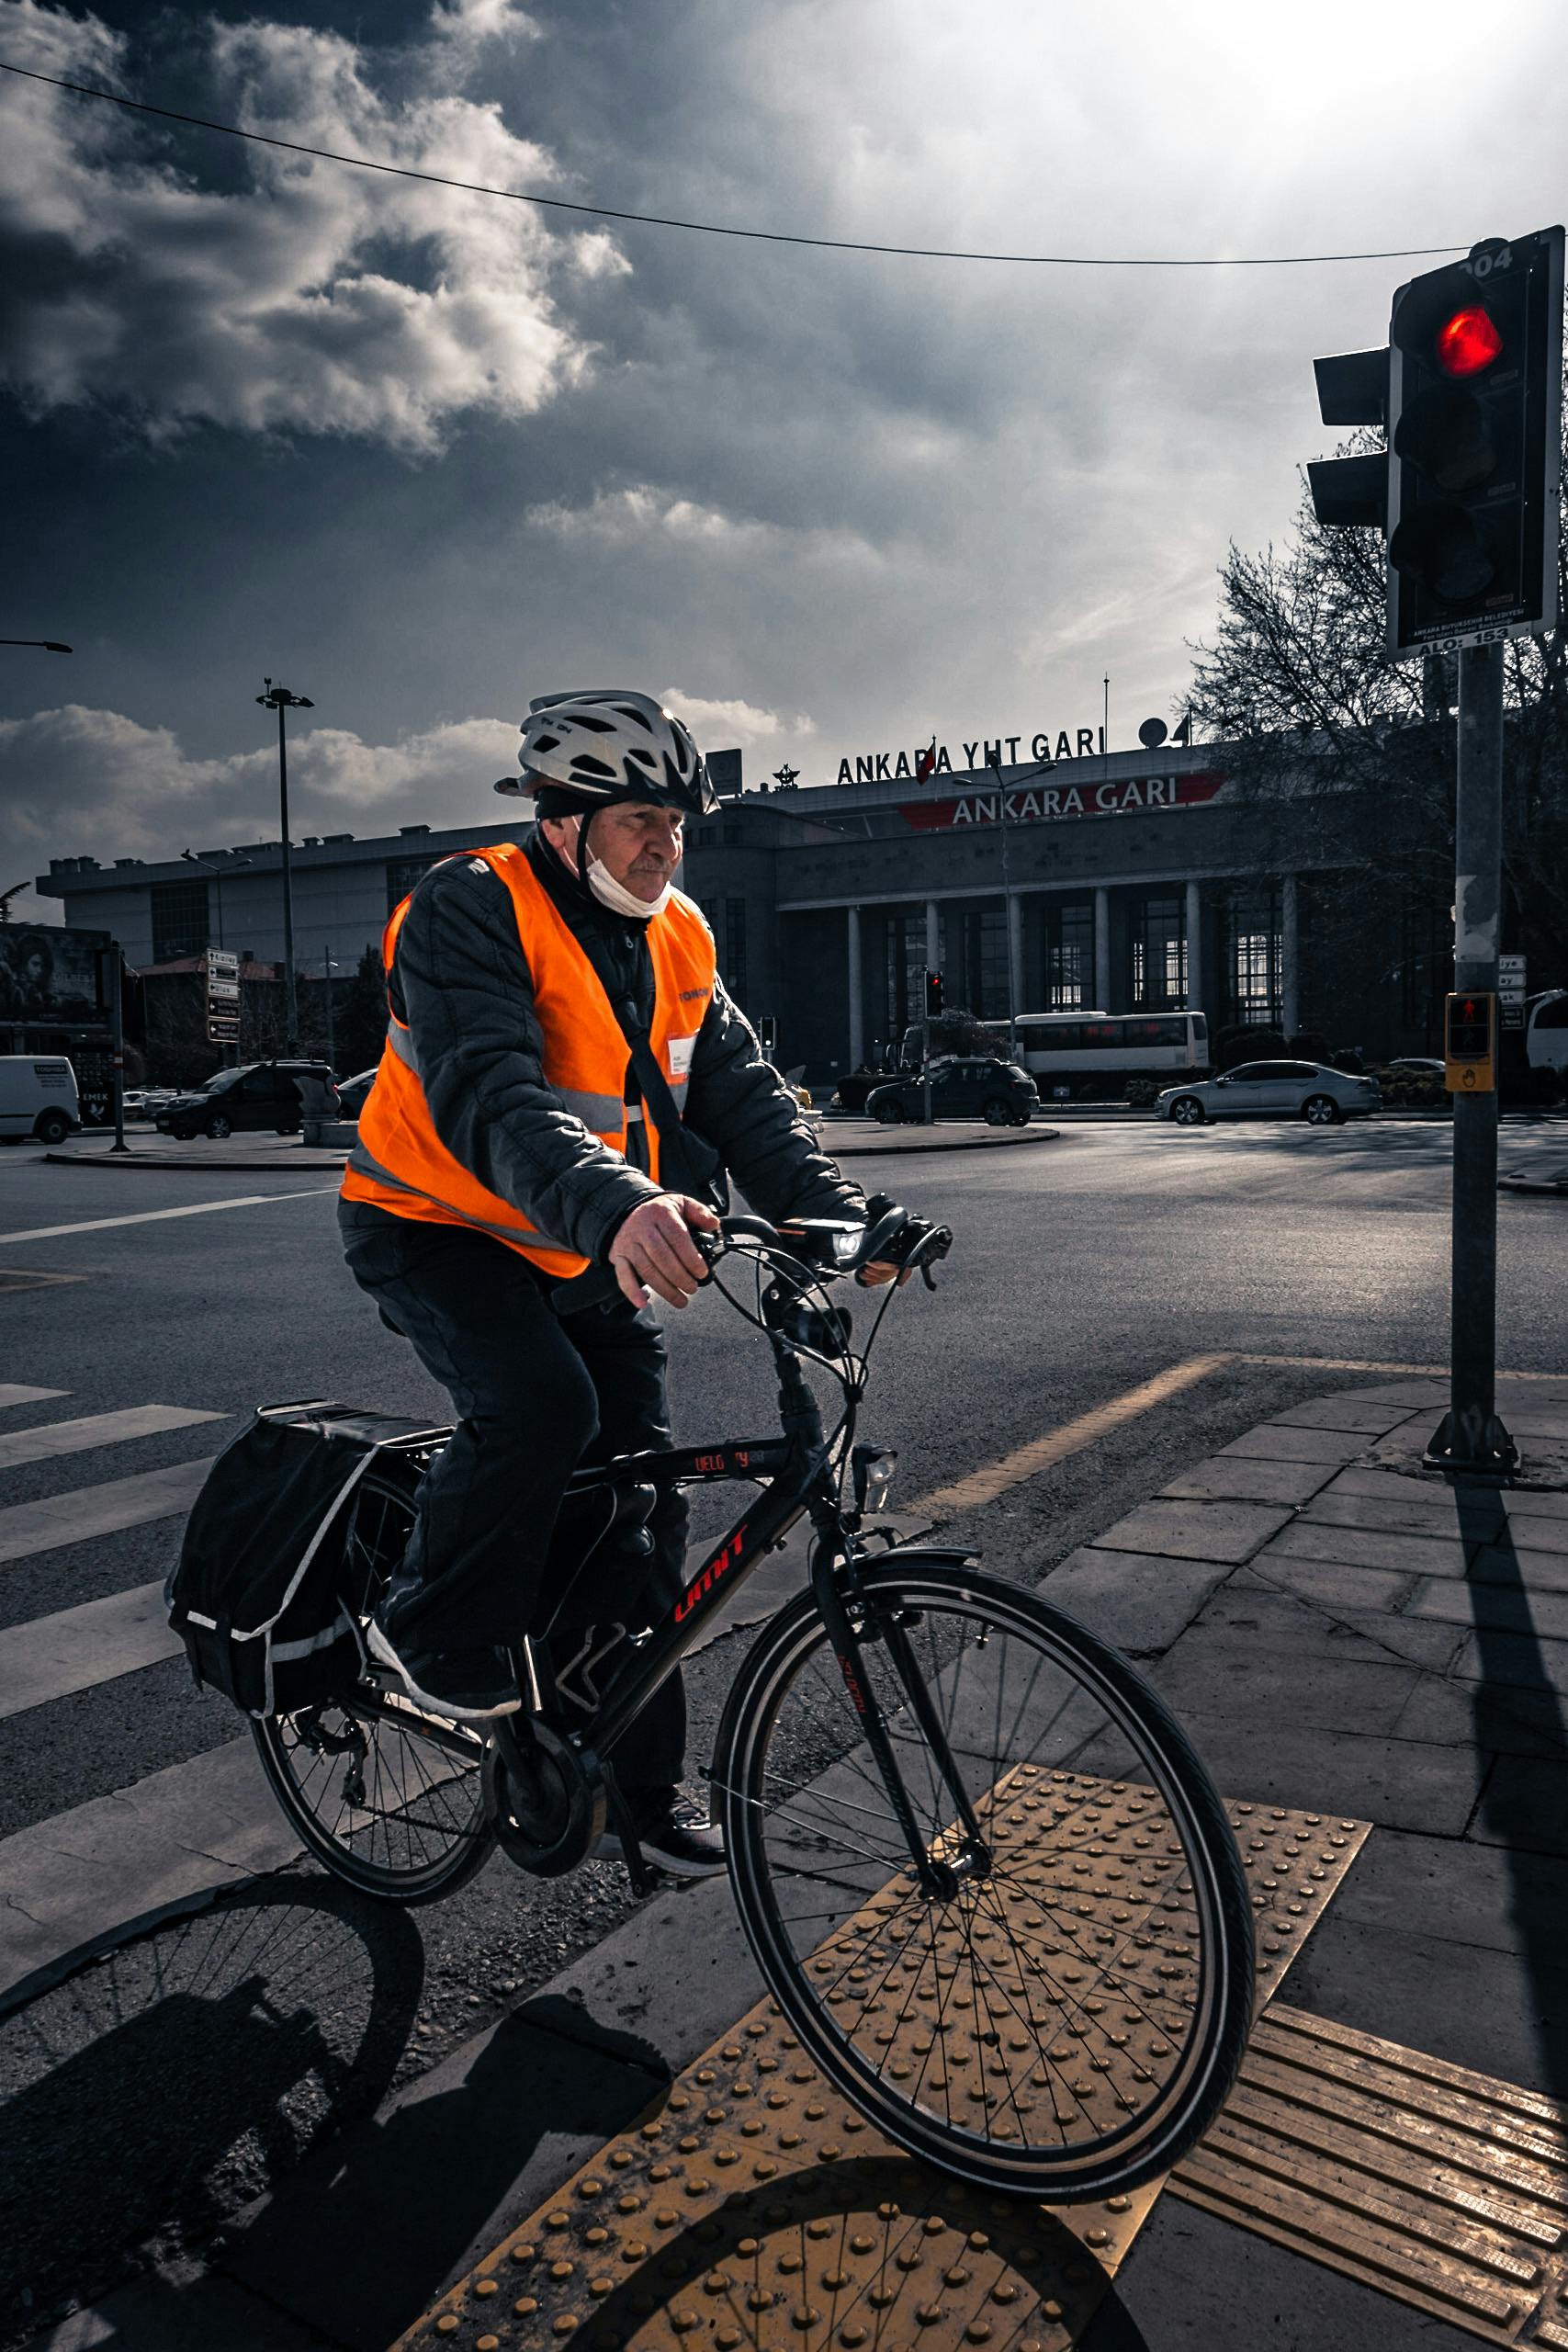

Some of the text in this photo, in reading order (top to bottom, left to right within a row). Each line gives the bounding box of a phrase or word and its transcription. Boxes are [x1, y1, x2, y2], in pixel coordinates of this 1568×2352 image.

[1473, 628, 1508, 644] 153
[838, 726, 1105, 785] ANKARA YHT GARI
[952, 777, 1177, 824] ANKARA GARI
